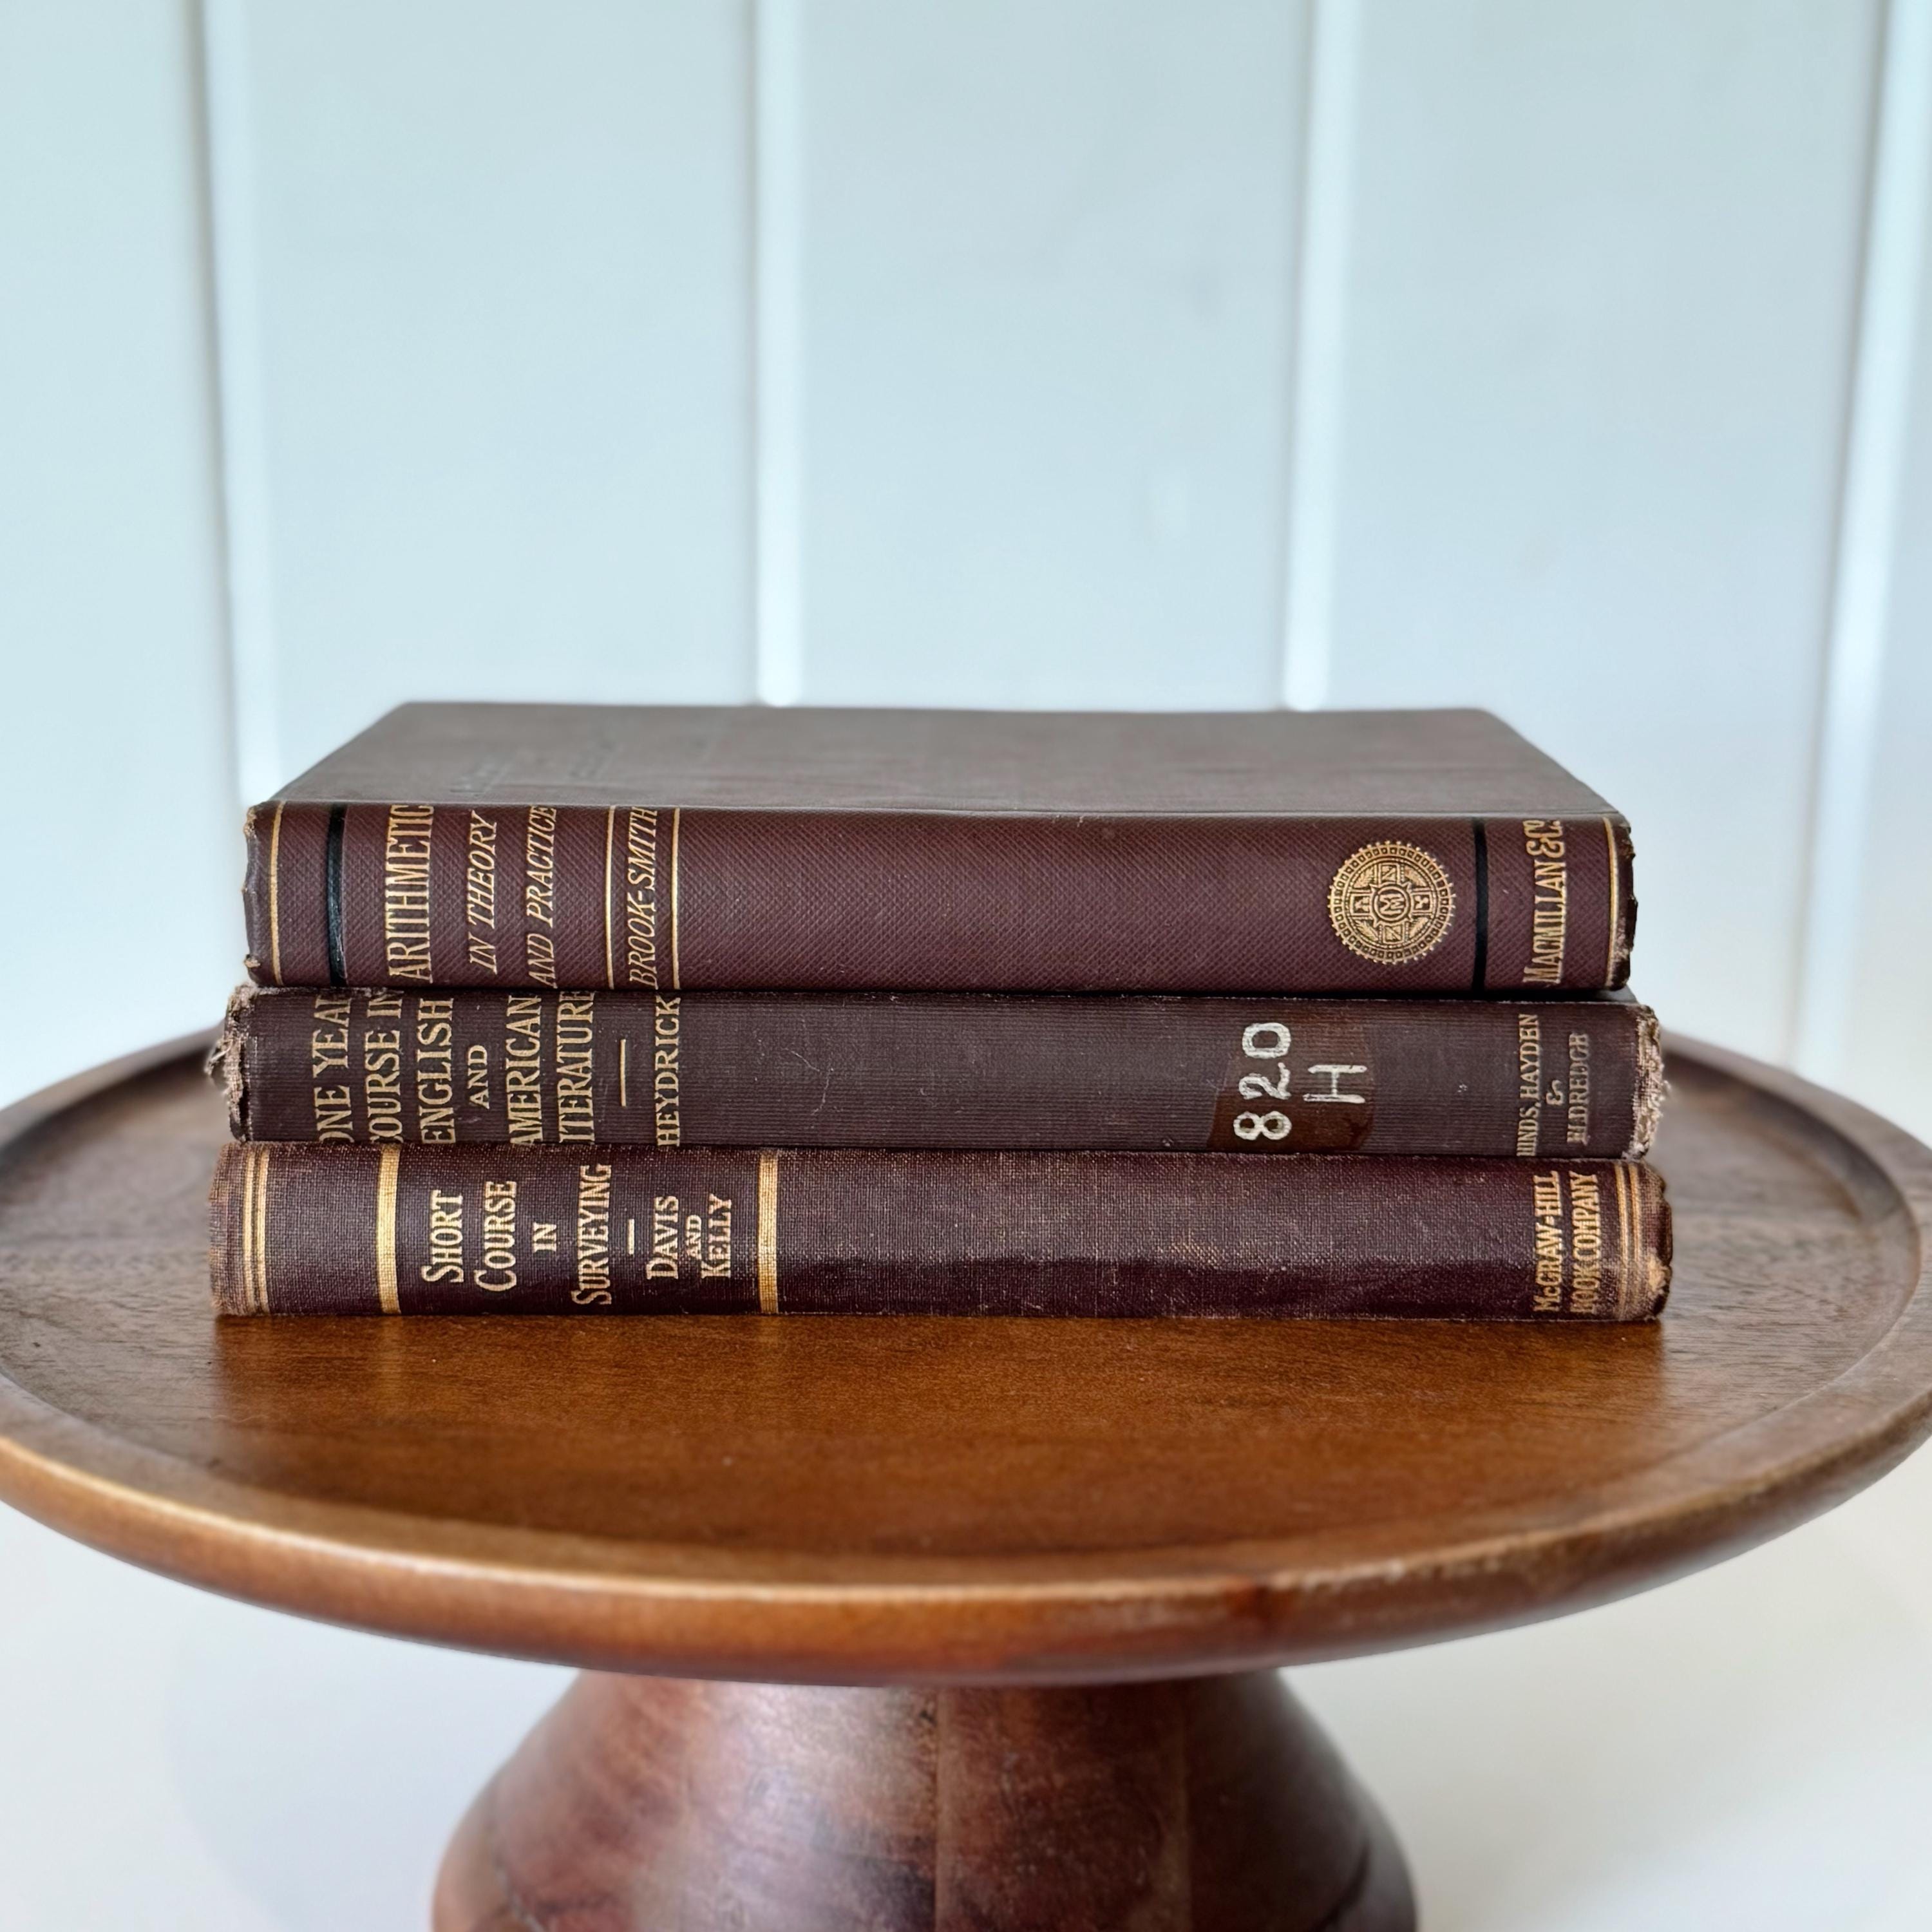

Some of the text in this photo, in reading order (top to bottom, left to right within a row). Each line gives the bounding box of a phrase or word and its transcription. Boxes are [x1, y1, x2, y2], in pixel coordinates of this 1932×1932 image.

[387, 804, 435, 984] ARITHMETIC
[468, 810, 498, 972] IN THEORY
[527, 806, 558, 987] AND PRACTICE
[627, 808, 659, 987] BROOK-SMITH
[1524, 860, 1567, 984] MACMILLAN
[418, 998, 455, 1142] ENGLISH
[468, 1045, 490, 1108] AND
[507, 995, 544, 1142] AMERICAN
[558, 992, 594, 1142] ITERATURE
[655, 995, 680, 1146] HEYDRICK
[1233, 1021, 1293, 1142] 820
[1303, 1063, 1367, 1104] H
[1519, 1014, 1540, 1100] HAYDEN
[1546, 1080, 1564, 1106] &
[421, 1189, 464, 1282] SHORT
[473, 1181, 516, 1291] COURSE
[533, 1223, 557, 1252] IN
[572, 1164, 612, 1305] SURVEYING
[645, 1196, 679, 1279] DAVIS
[687, 1215, 702, 1260] AND
[703, 1193, 732, 1278] KELLY
[1568, 1171, 1600, 1314] BOOK COMPANY
